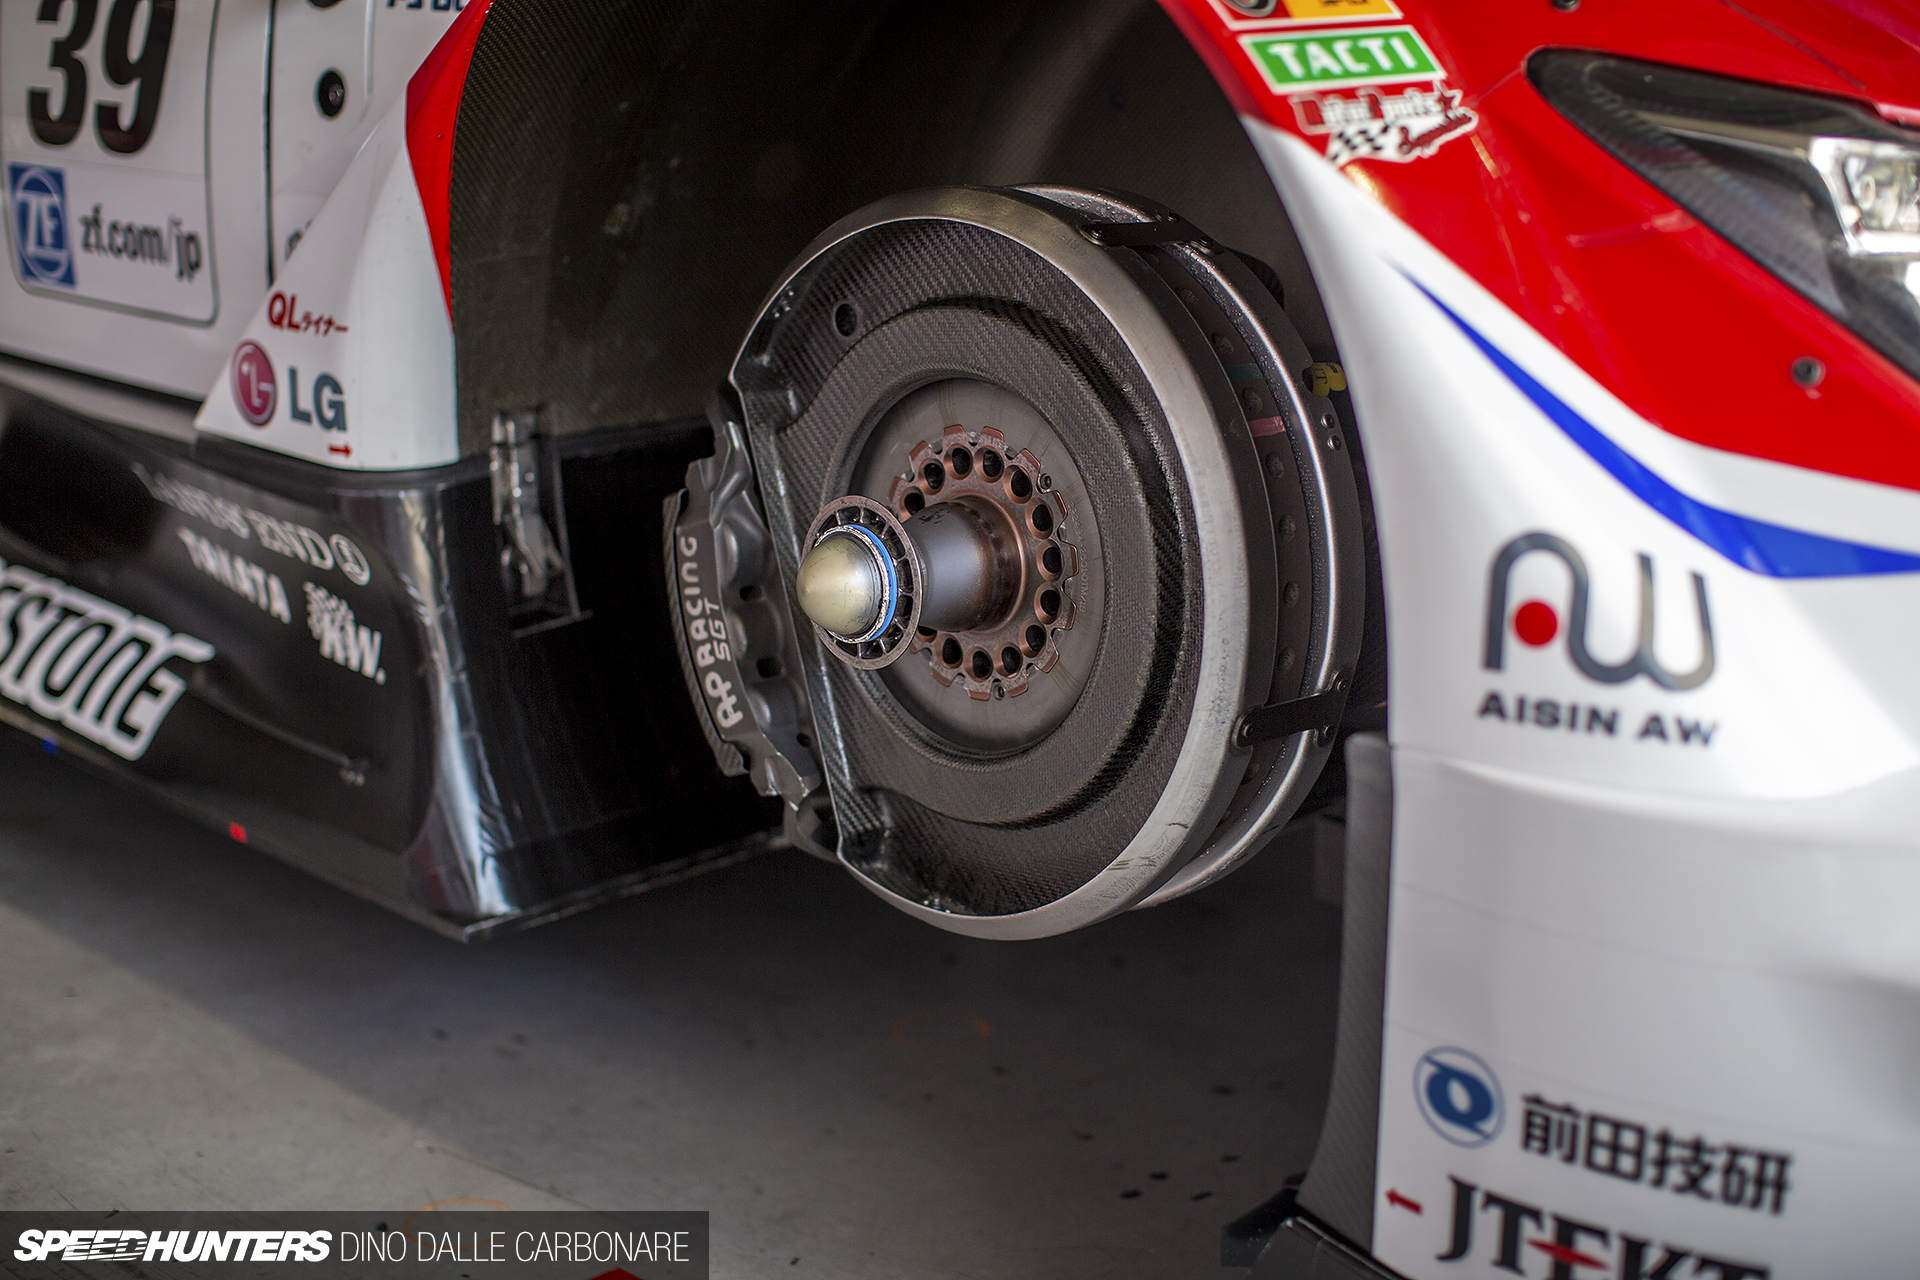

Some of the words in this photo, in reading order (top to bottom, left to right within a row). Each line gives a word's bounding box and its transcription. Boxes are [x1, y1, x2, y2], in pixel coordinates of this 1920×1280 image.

[26, 0, 178, 154] 39
[1267, 36, 1418, 79] TACTI
[79, 203, 202, 282] zf.com/jp
[288, 366, 348, 432] LG
[246, 509, 335, 571] END
[679, 535, 716, 668] RACING
[704, 597, 732, 662] SGT
[705, 671, 744, 729] AP
[1477, 690, 1619, 737] AISIN
[1636, 711, 1721, 747] AW
[1520, 1092, 1796, 1216] 前田技研
